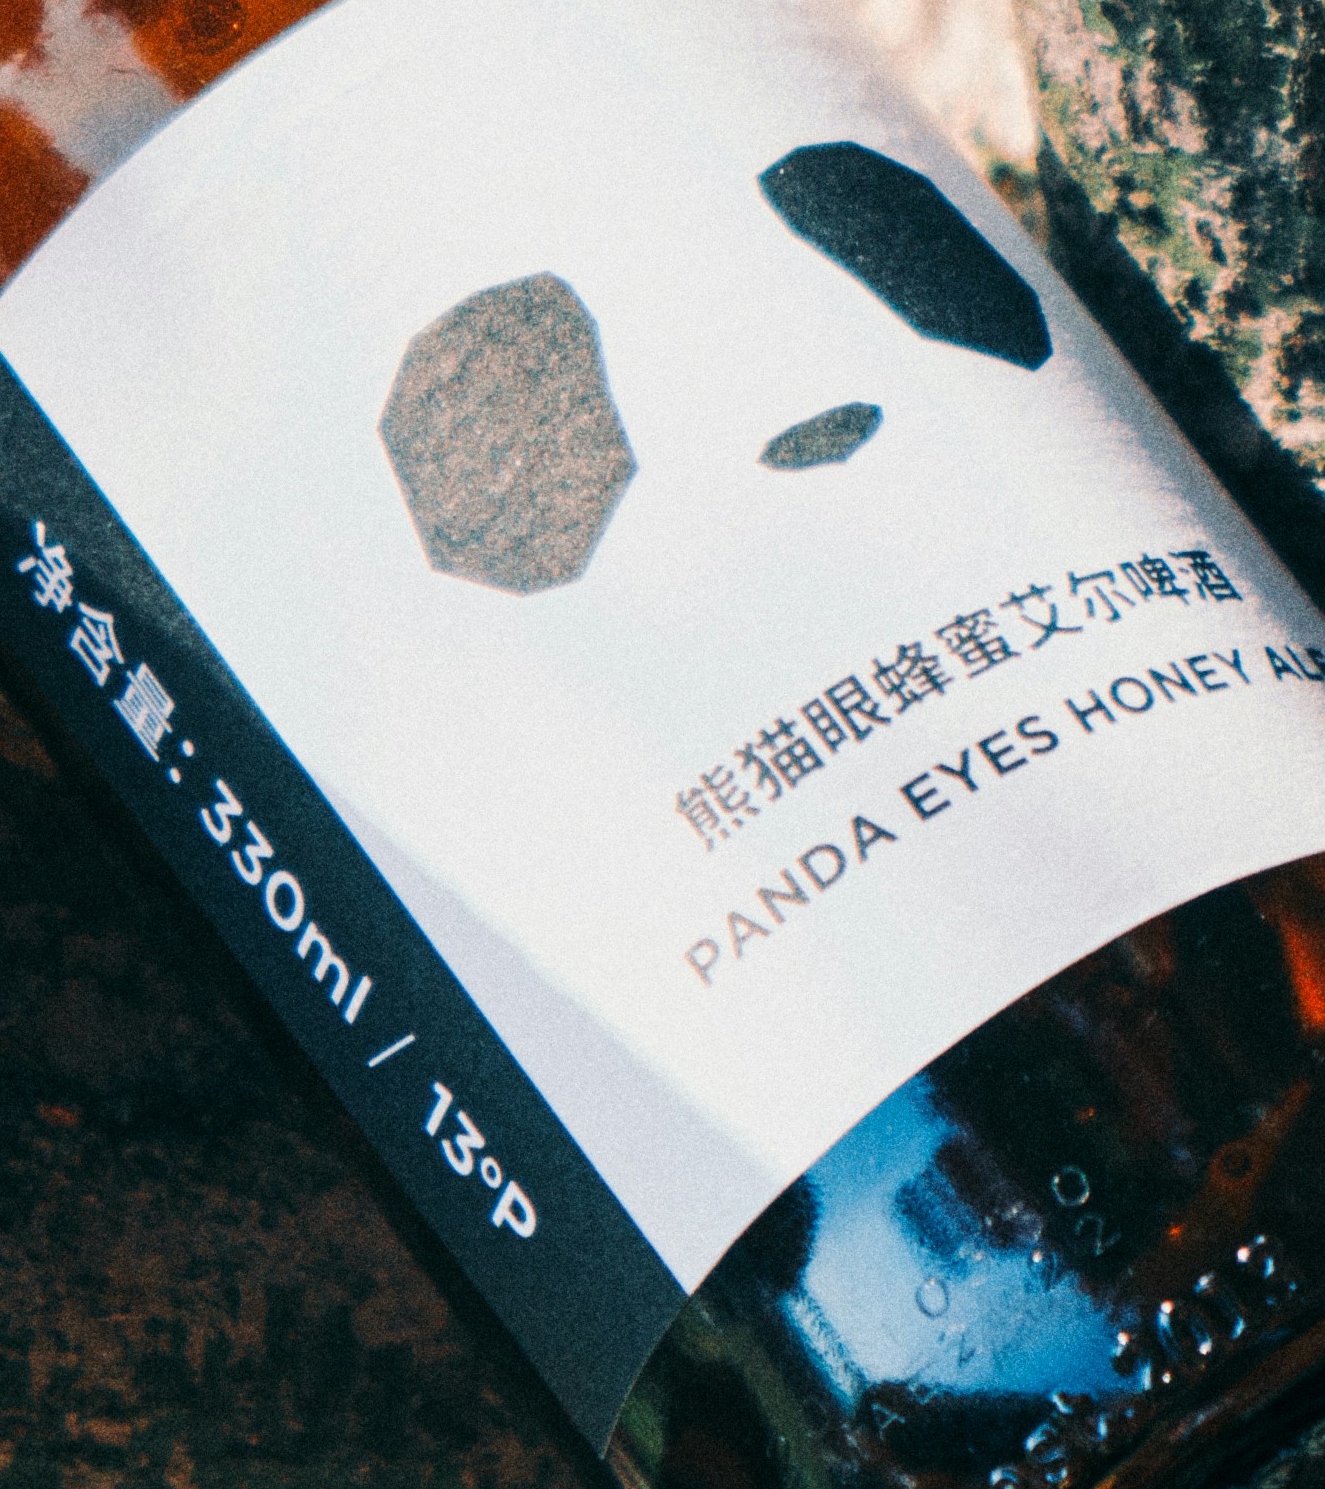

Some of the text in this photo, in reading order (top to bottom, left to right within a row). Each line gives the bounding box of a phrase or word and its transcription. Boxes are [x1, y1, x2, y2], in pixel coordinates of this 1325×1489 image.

[674, 546, 1245, 854] 熊猫眼蜂蜜艾尔啤酒
[681, 812, 901, 989] PANDA
[897, 712, 1063, 824] EYES
[1063, 645, 1252, 736] HONEY
